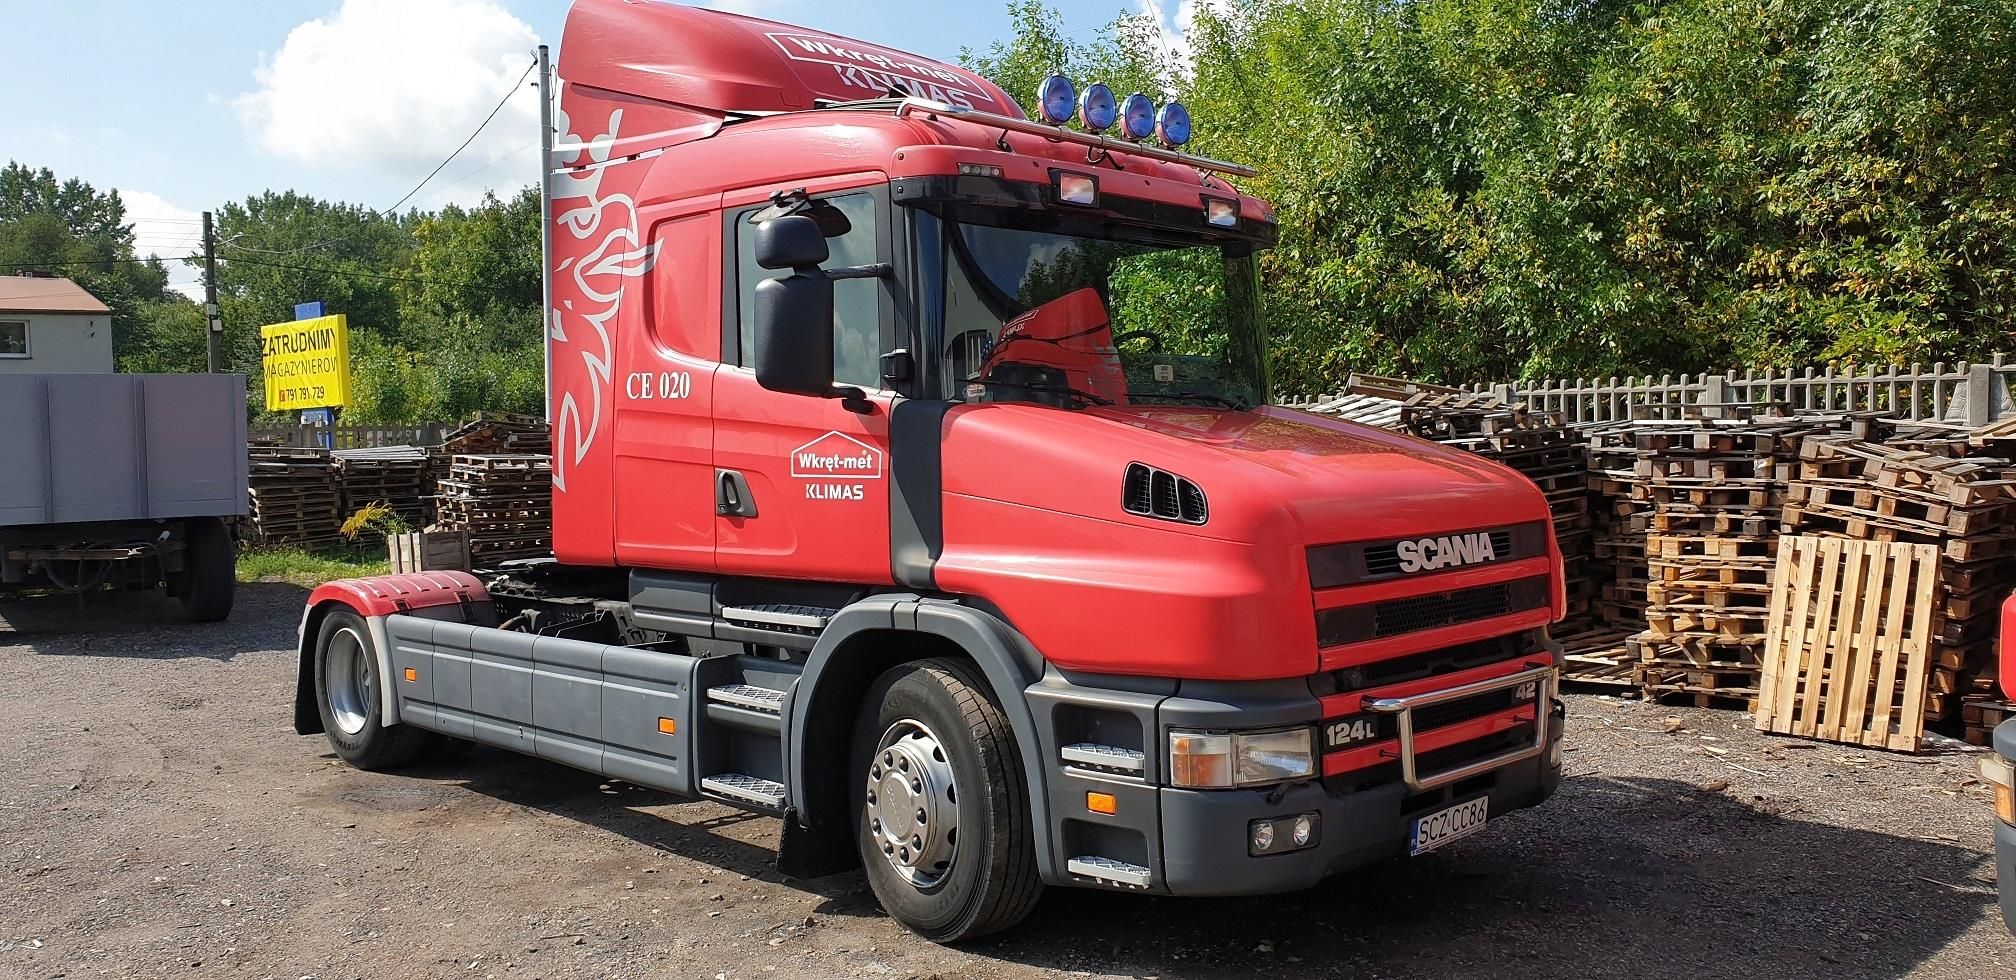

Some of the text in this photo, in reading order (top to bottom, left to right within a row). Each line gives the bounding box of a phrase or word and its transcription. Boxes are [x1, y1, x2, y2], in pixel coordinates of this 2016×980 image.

[833, 64, 973, 109] KLIMAS
[262, 328, 336, 357] ZATRUDNIMY
[286, 385, 325, 401] 791 791 729
[626, 371, 690, 399] CE 020
[799, 451, 872, 472] Wkręt-met
[805, 483, 864, 500] KLIMAS
[1397, 532, 1496, 573] SCANIA
[1515, 682, 1536, 699] 42
[1419, 812, 1448, 844] SCZ
[1452, 799, 1486, 832] CC86
